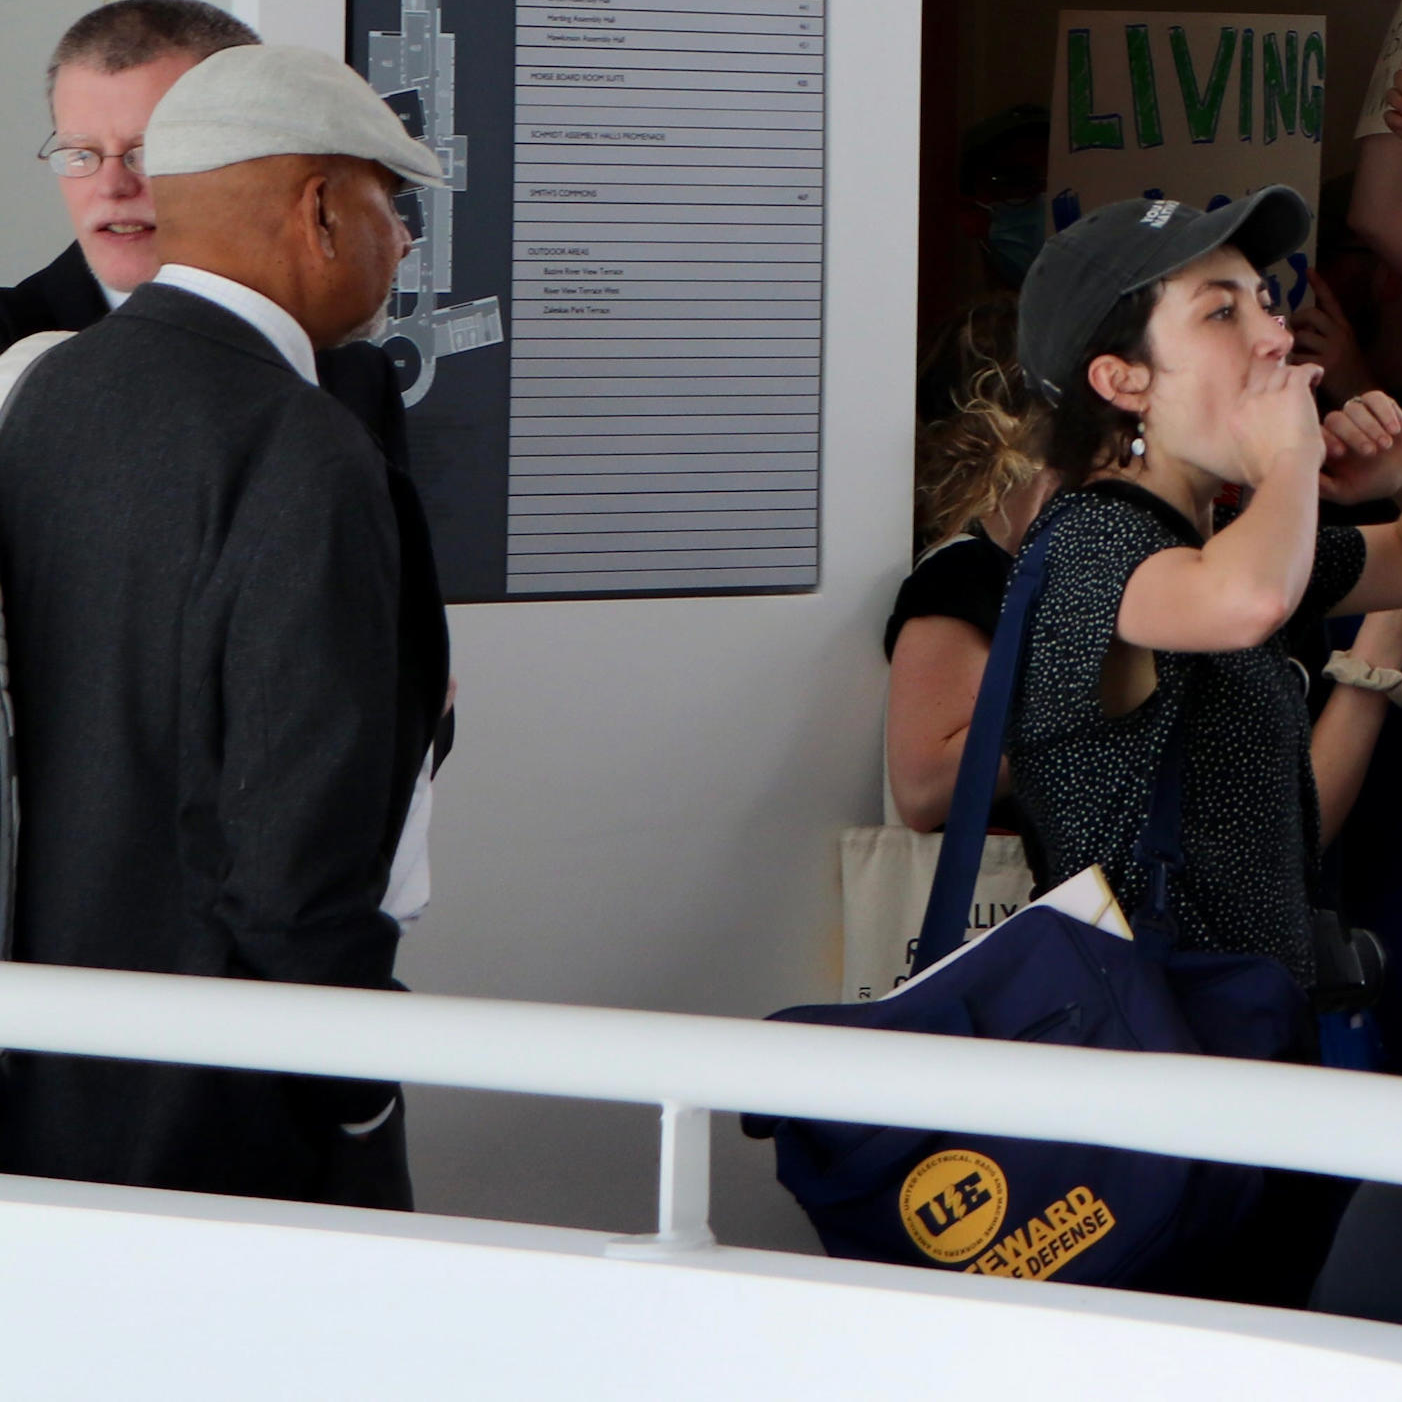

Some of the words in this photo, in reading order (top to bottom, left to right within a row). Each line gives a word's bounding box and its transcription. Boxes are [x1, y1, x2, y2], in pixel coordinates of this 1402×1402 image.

[1068, 24, 1326, 154] LIVING
[964, 1186, 1097, 1274] EWARD
[1026, 1207, 1109, 1277] DEFENSE
